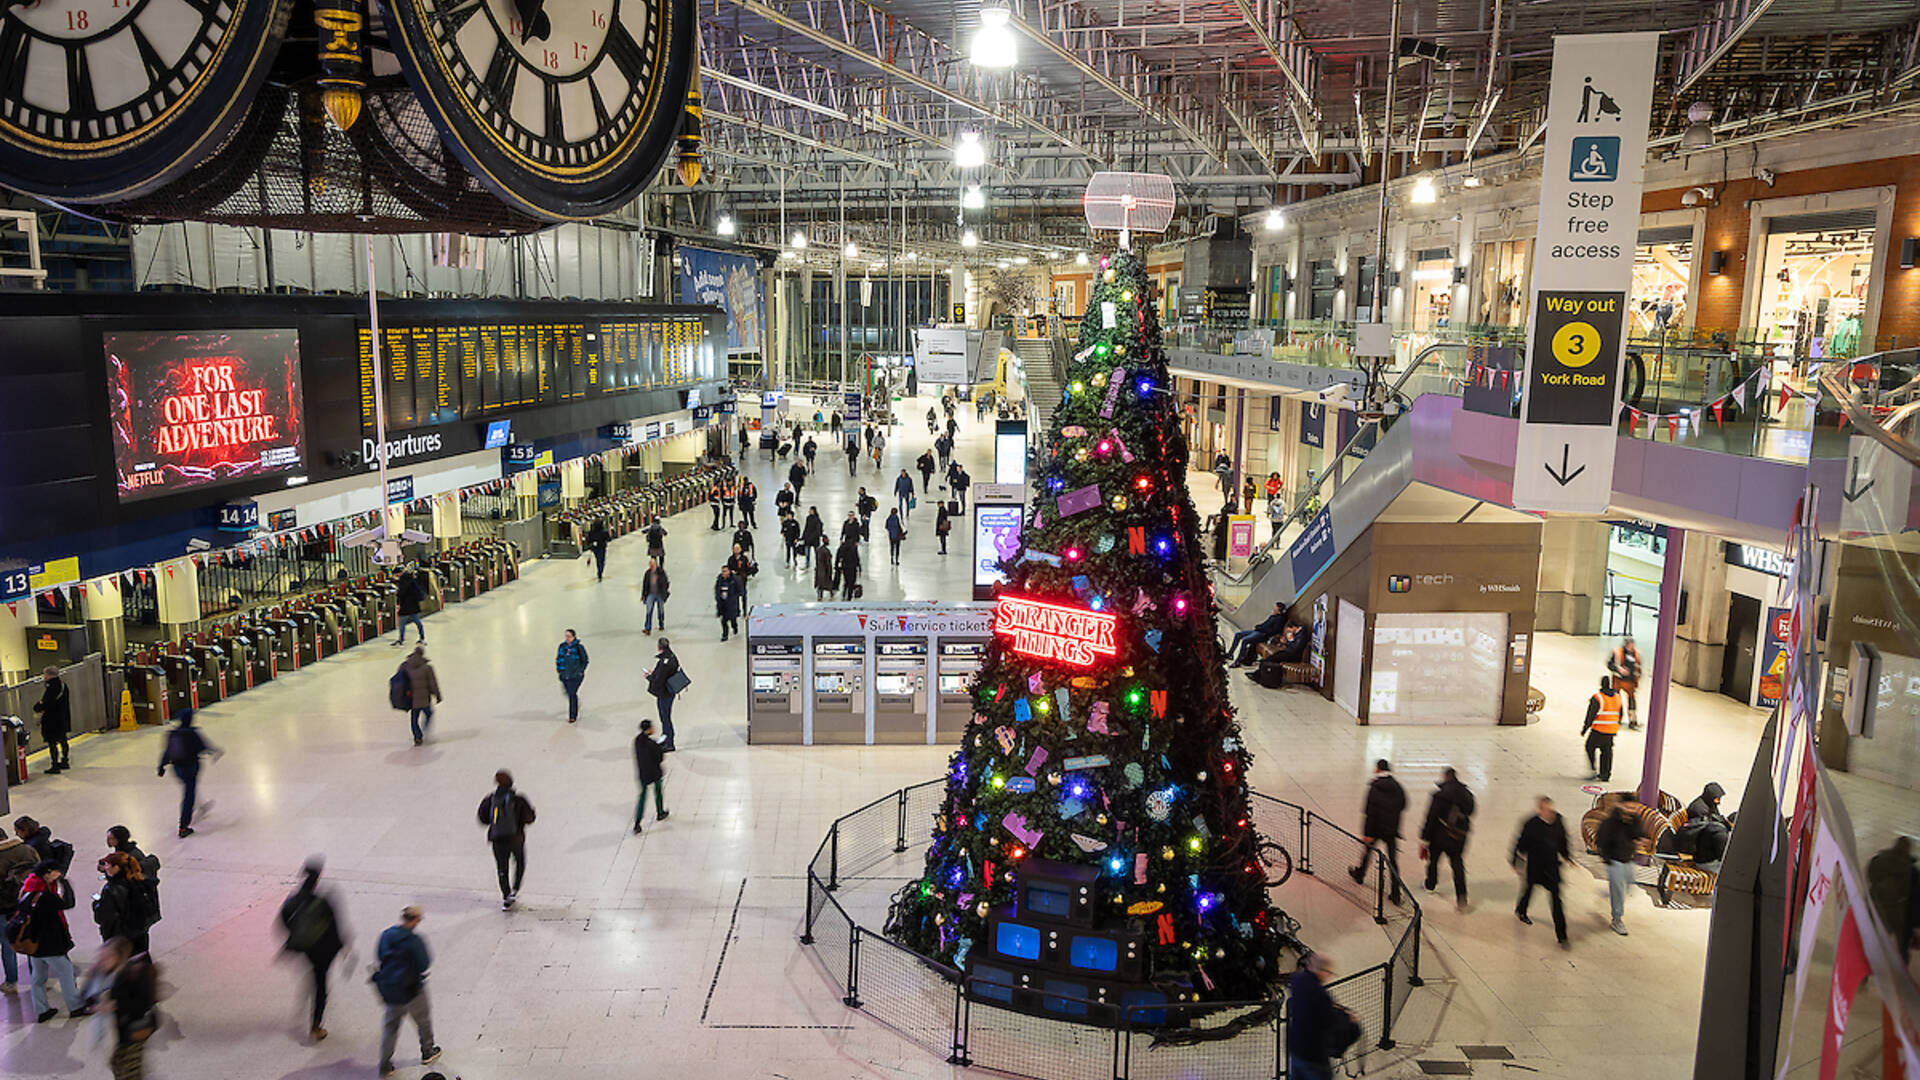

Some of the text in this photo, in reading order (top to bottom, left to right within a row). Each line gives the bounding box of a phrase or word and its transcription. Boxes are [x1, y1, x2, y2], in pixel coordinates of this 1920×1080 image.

[65, 10, 89, 31] 18
[592, 9, 606, 30] 16
[543, 48, 559, 70] 18
[574, 41, 588, 62] 17
[1567, 191, 1614, 211] Step
[1568, 216, 1609, 233] free
[1551, 245, 1620, 258] access
[1546, 297, 1616, 315] Way out
[1568, 334, 1585, 355] 3
[192, 365, 235, 393] FOR
[1541, 373, 1606, 386] York Road
[164, 389, 264, 424] ONE LAST
[698, 408, 707, 417] 17
[157, 415, 279, 455] ADVENTURE.
[613, 426, 625, 436] 16
[363, 433, 442, 465] Departures
[510, 448, 524, 459] 15
[127, 469, 164, 489] NETFLIX
[220, 509, 241, 524] 14
[243, 507, 257, 522] 14
[5, 573, 28, 594] 13
[1415, 574, 1454, 585] tech
[870, 619, 946, 632] Slf-ervice
[997, 600, 1116, 650] STRANGER
[1013, 630, 1095, 666] THINGS
